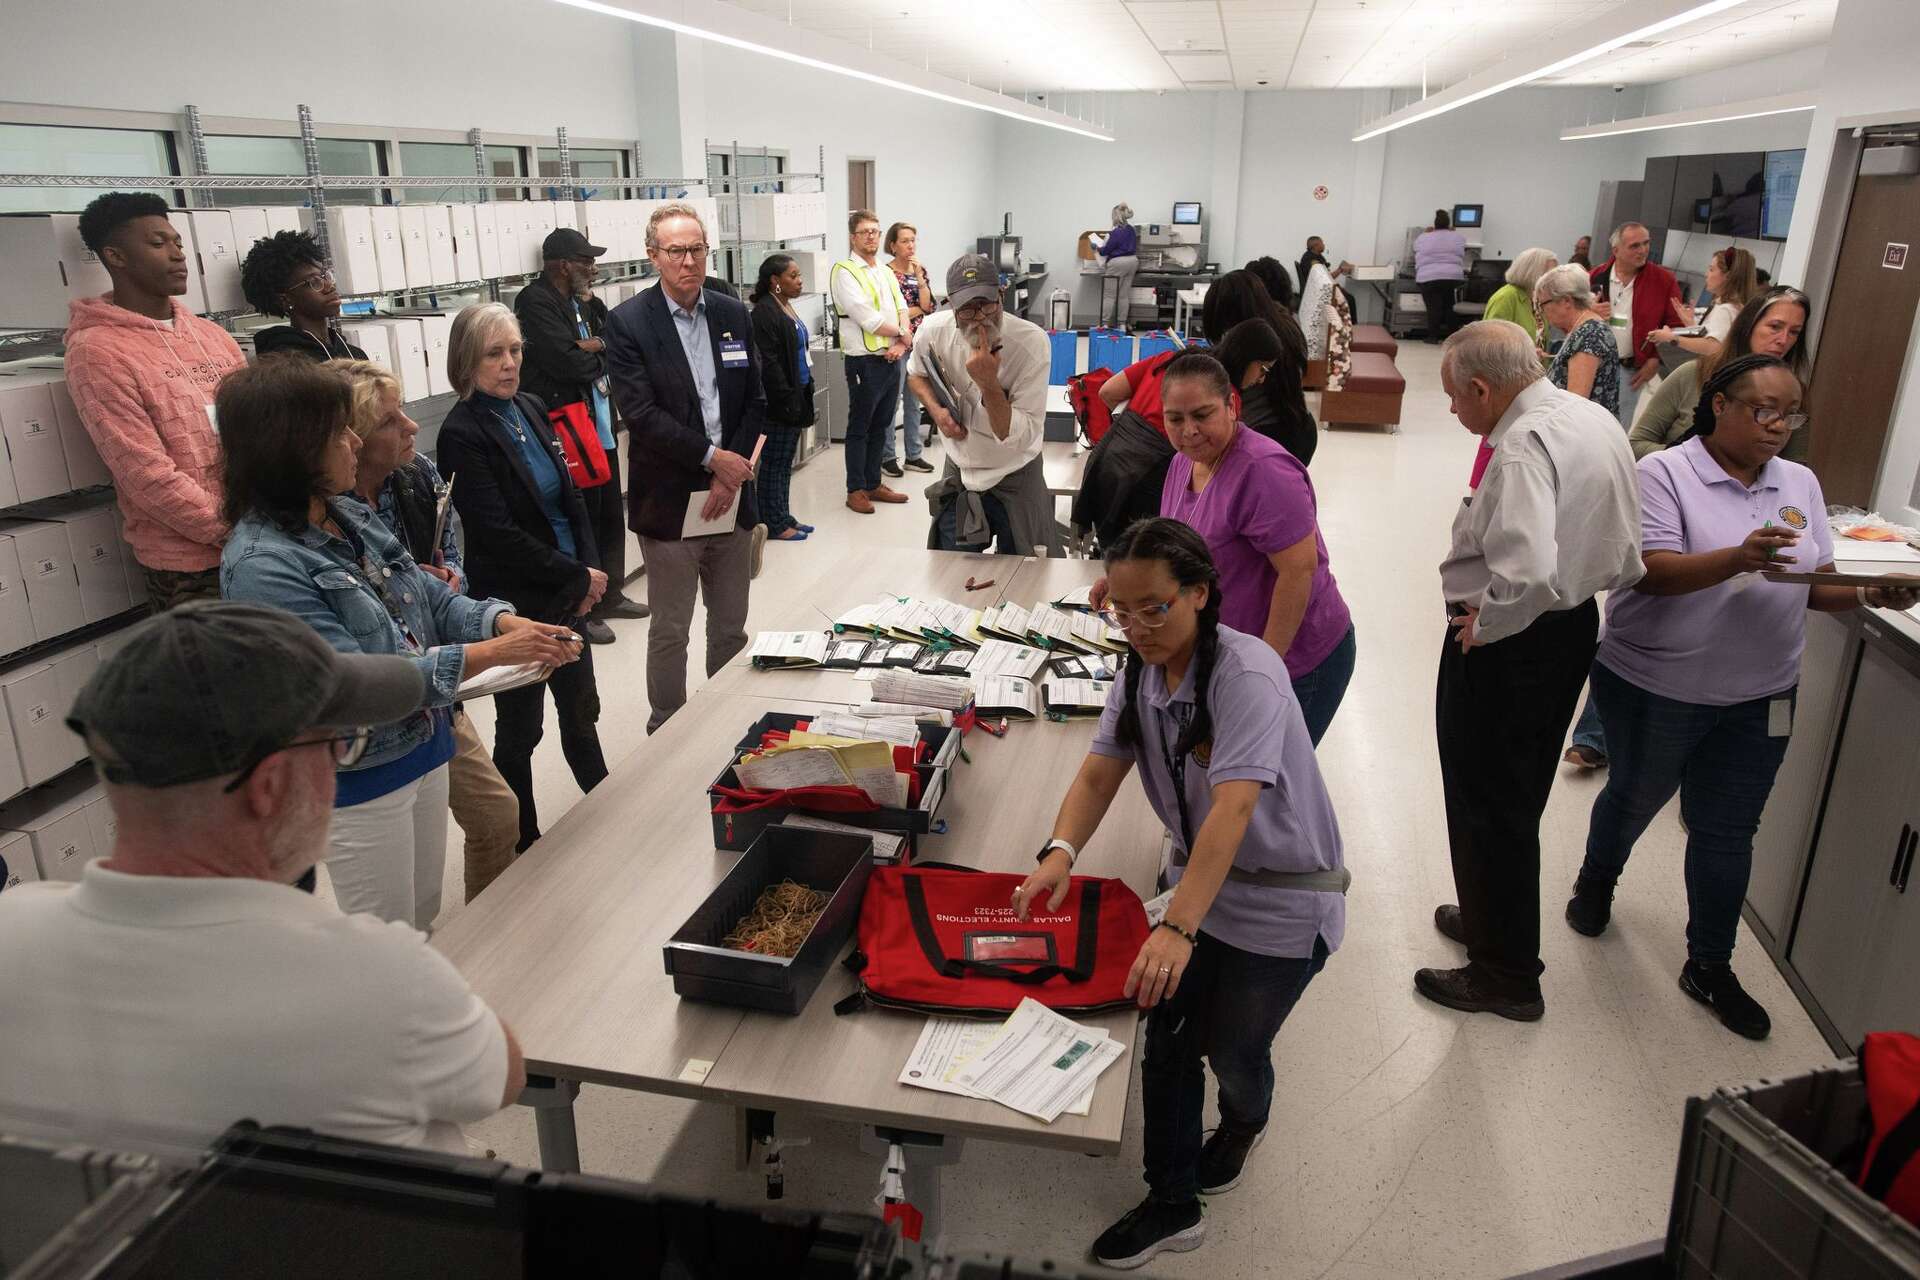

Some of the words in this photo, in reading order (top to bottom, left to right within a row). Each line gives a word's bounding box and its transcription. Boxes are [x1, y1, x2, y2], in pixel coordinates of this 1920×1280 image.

[165, 360, 233, 378] CAFORNIA
[936, 913, 990, 923] ELECTIONS
[992, 915, 1023, 923] UNTY
[1033, 915, 1072, 923] DALLAS
